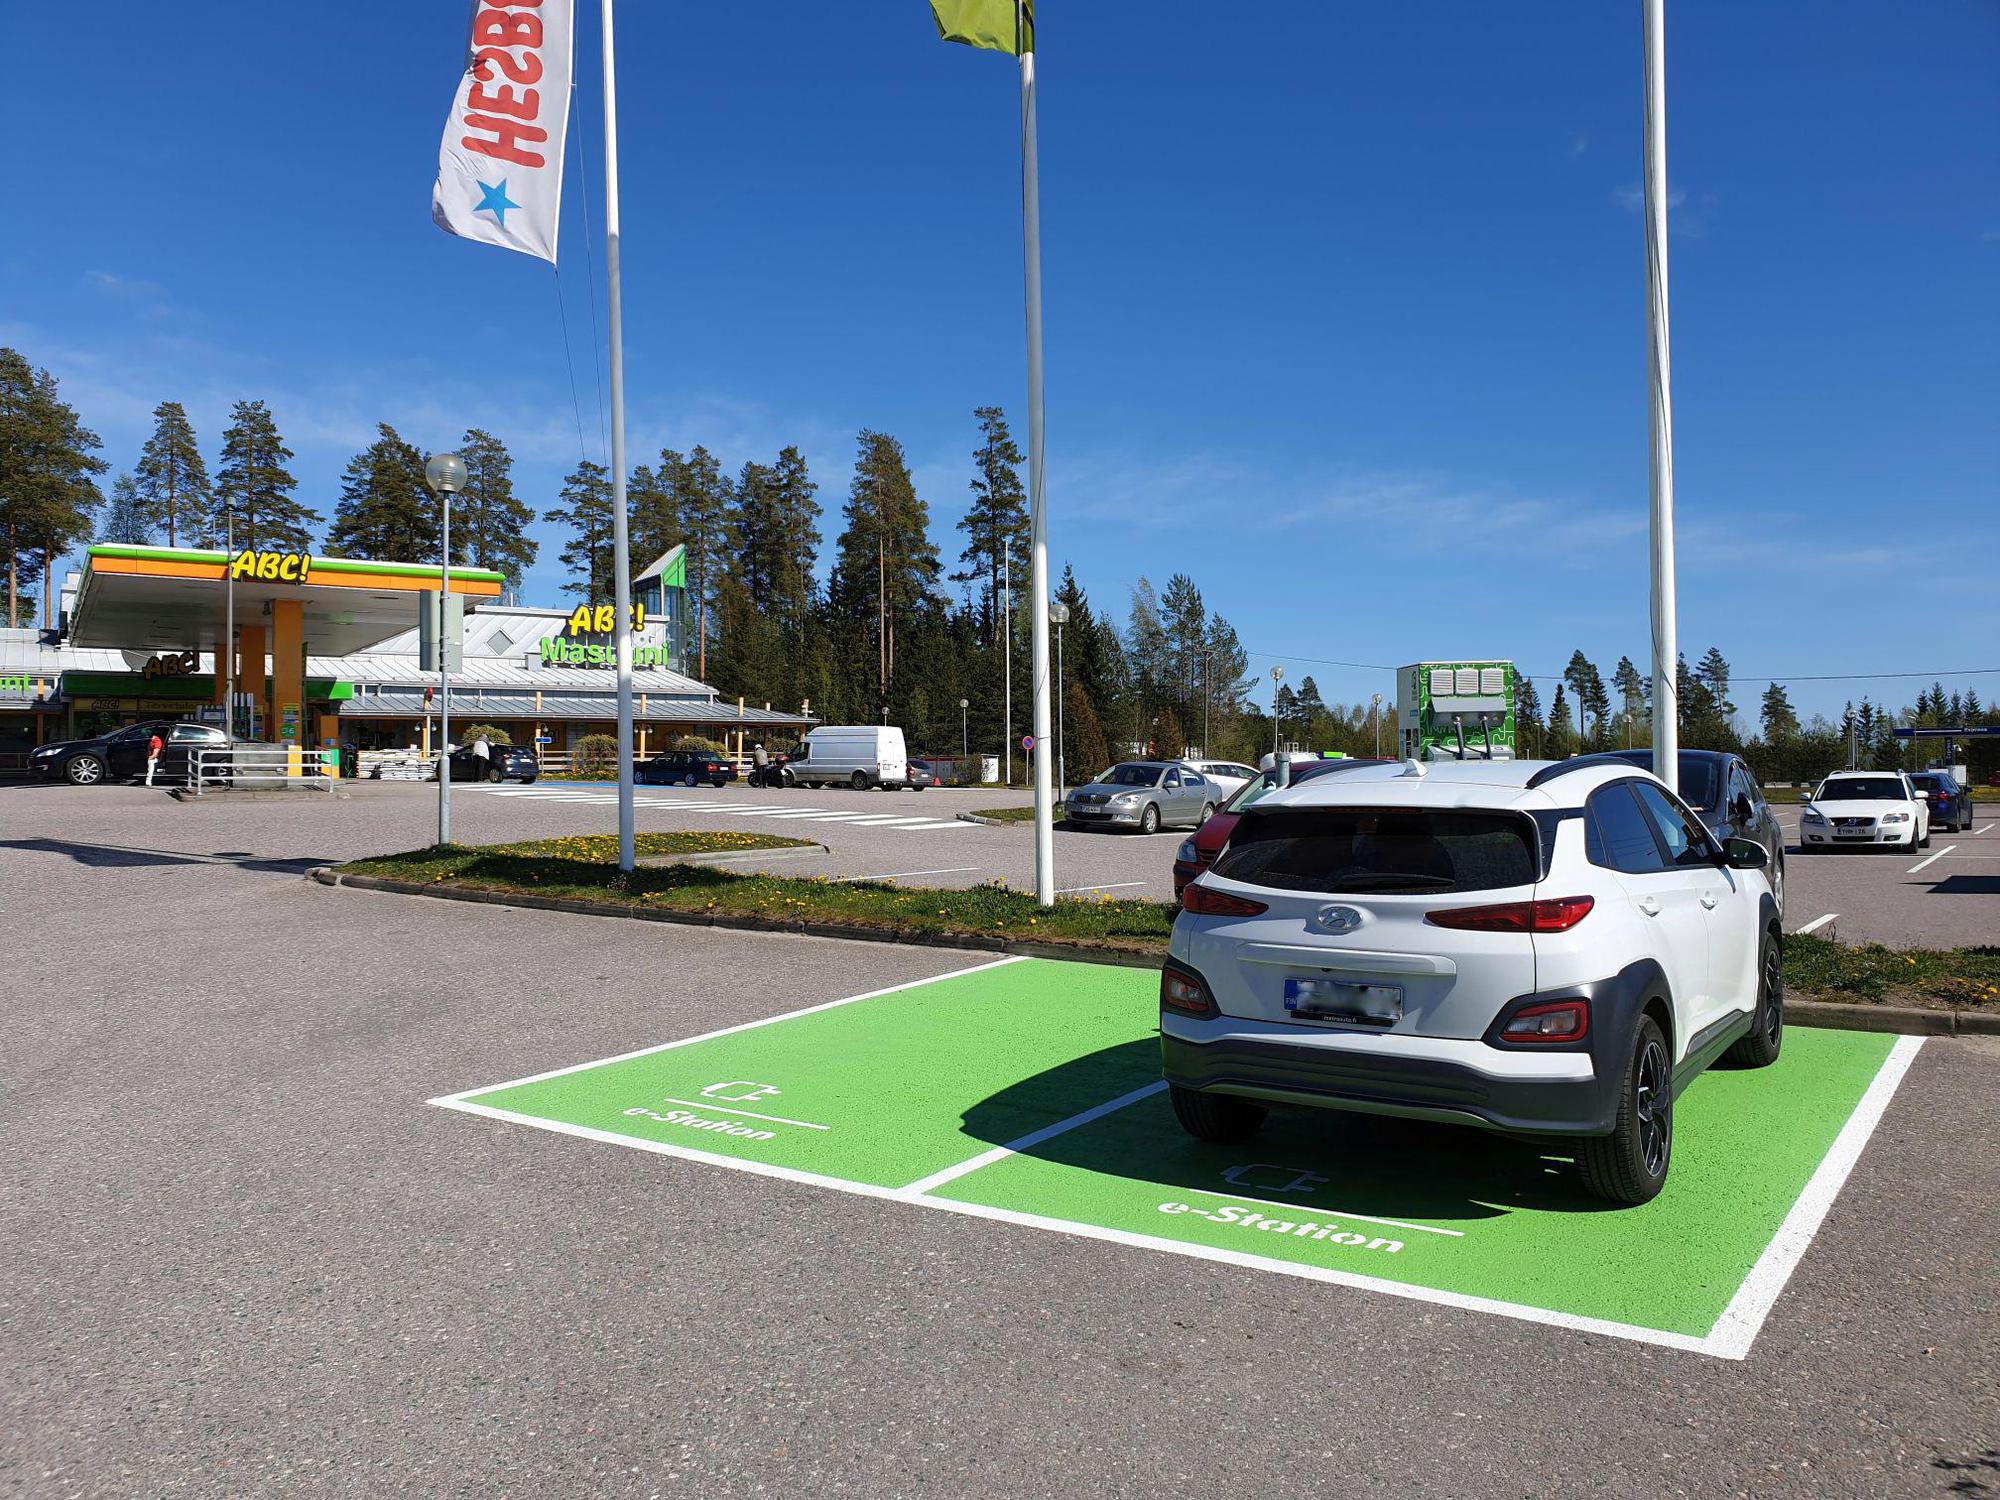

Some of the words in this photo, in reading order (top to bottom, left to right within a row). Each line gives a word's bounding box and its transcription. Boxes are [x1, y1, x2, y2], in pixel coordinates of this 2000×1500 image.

[231, 550, 311, 581] ABC!
[568, 602, 645, 636] AB!
[142, 651, 200, 680] ABC!
[623, 1108, 777, 1141] e-Station
[1157, 1201, 1405, 1254] e-Station
